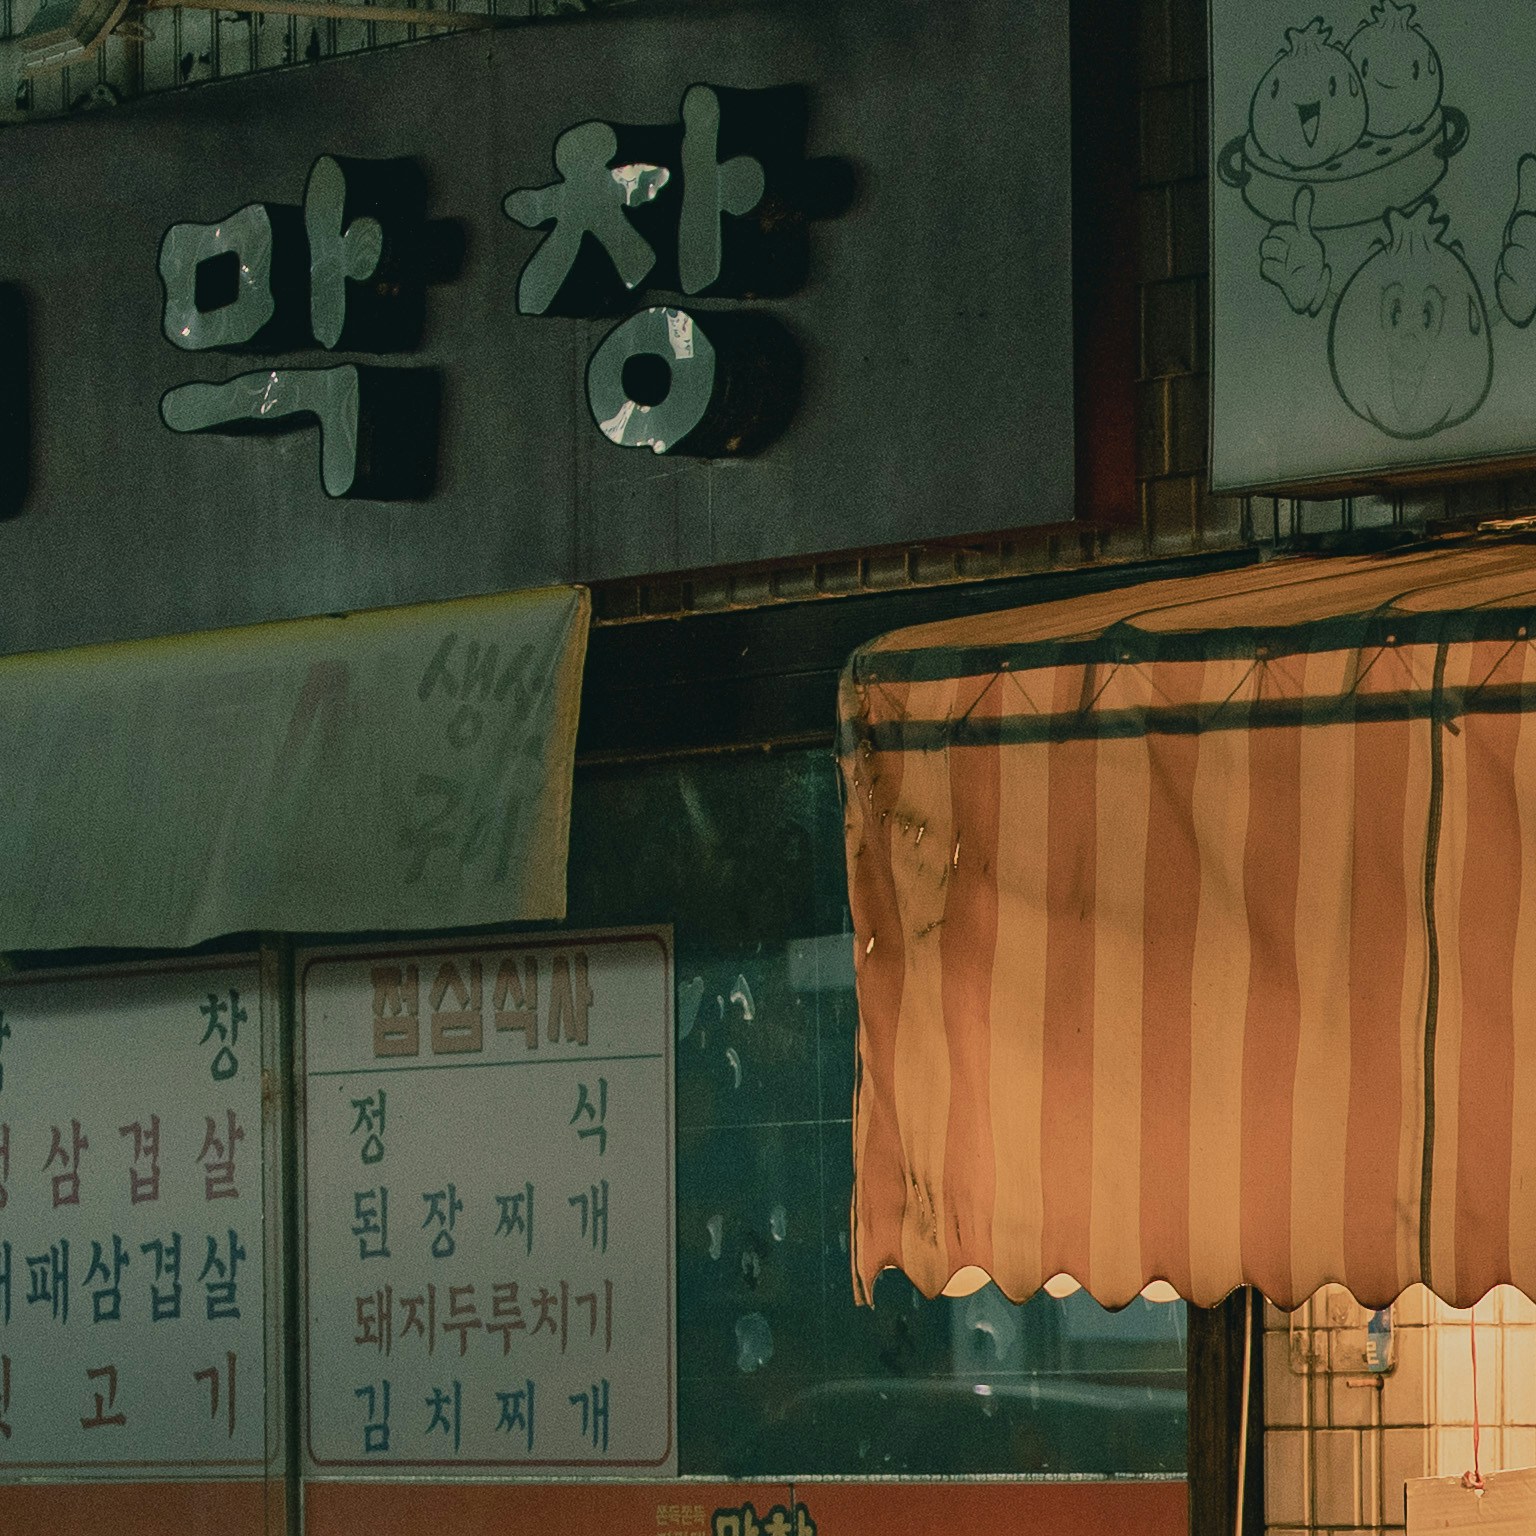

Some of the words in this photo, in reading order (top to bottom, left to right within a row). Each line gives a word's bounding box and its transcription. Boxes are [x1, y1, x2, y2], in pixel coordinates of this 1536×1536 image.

[160, 83, 766, 498] 막창
[372, 951, 595, 1058] 점심식사
[0, 1108, 245, 1208] 삼겹살
[350, 1179, 610, 1261] 된장찌개
[0, 1229, 247, 1326] 패삼겹살
[353, 1279, 614, 1357] 돼지두루치기
[0, 1350, 237, 1440] 고기
[353, 1376, 610, 1454] 김치찌개
